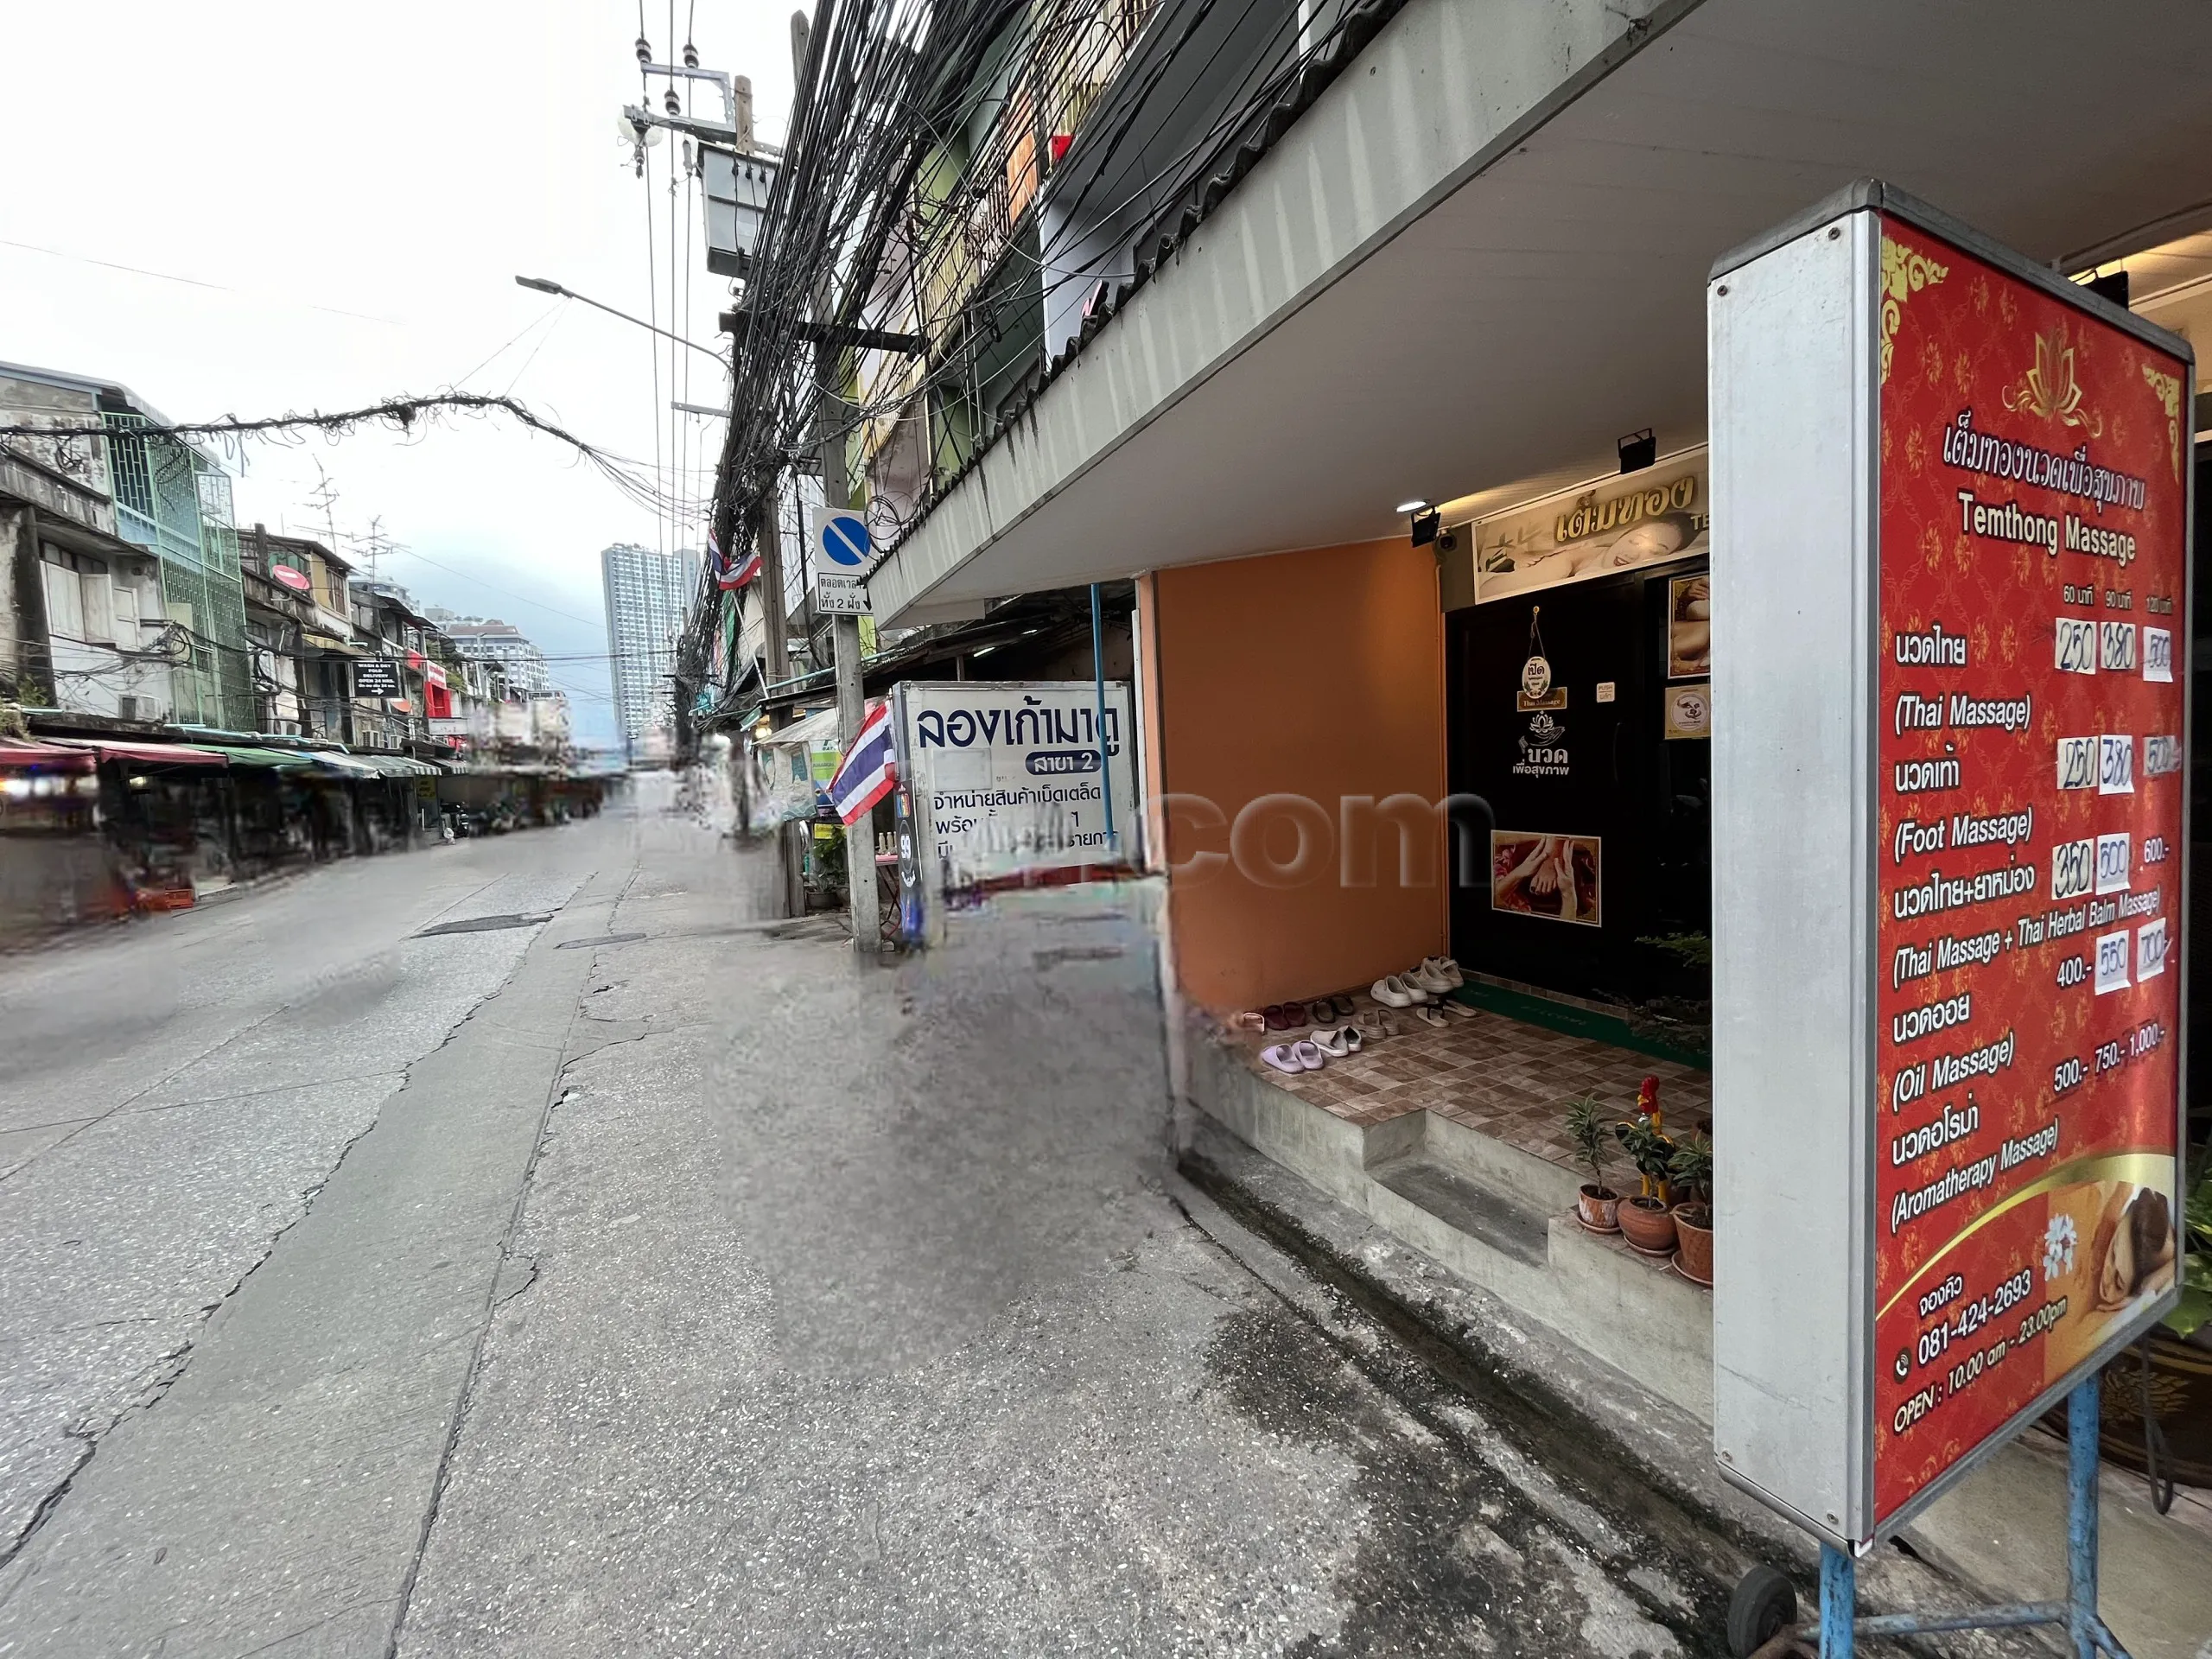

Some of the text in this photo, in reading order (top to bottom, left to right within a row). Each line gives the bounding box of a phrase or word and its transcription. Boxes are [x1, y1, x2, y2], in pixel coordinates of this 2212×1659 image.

[1958, 492, 2136, 566] Temthong Massage
[836, 598, 844, 609] 2
[2063, 584, 2075, 604] 60
[2105, 590, 2116, 608] 90
[1895, 623, 1967, 665] นวดไทย
[2060, 621, 2094, 672] 250
[2103, 622, 2134, 669] 380
[1895, 694, 2031, 735] (Thai Massage)
[1033, 752, 1094, 772] สาขา 2
[1528, 747, 1569, 765] นวด
[1895, 743, 1960, 792] นวดเท้า
[2063, 738, 2095, 788] 250
[2102, 739, 2133, 787] 380
[1894, 808, 2033, 863] (Foot Massage)
[2056, 842, 2090, 899] 350
[1893, 883, 2161, 989] (Thai Massage + Thai Herbal Balm Massage)
[2056, 956, 2093, 988] 400.-
[2101, 937, 2126, 976] 550
[1893, 994, 1971, 1043] นวดออย
[1892, 1031, 2015, 1112] (Oil Massage)
[2054, 1022, 2165, 1092] 500.- 750.- 1,000.-
[1891, 1117, 2059, 1234] (Aromatherapy Massage)
[1917, 1268, 2032, 1366] 081-424-2693
[1893, 1388, 1935, 1435] OPEN
[1948, 1351, 1984, 1395] 10.00
[1986, 1342, 2006, 1367] am
[2018, 1296, 2068, 1344] 23.00pm
